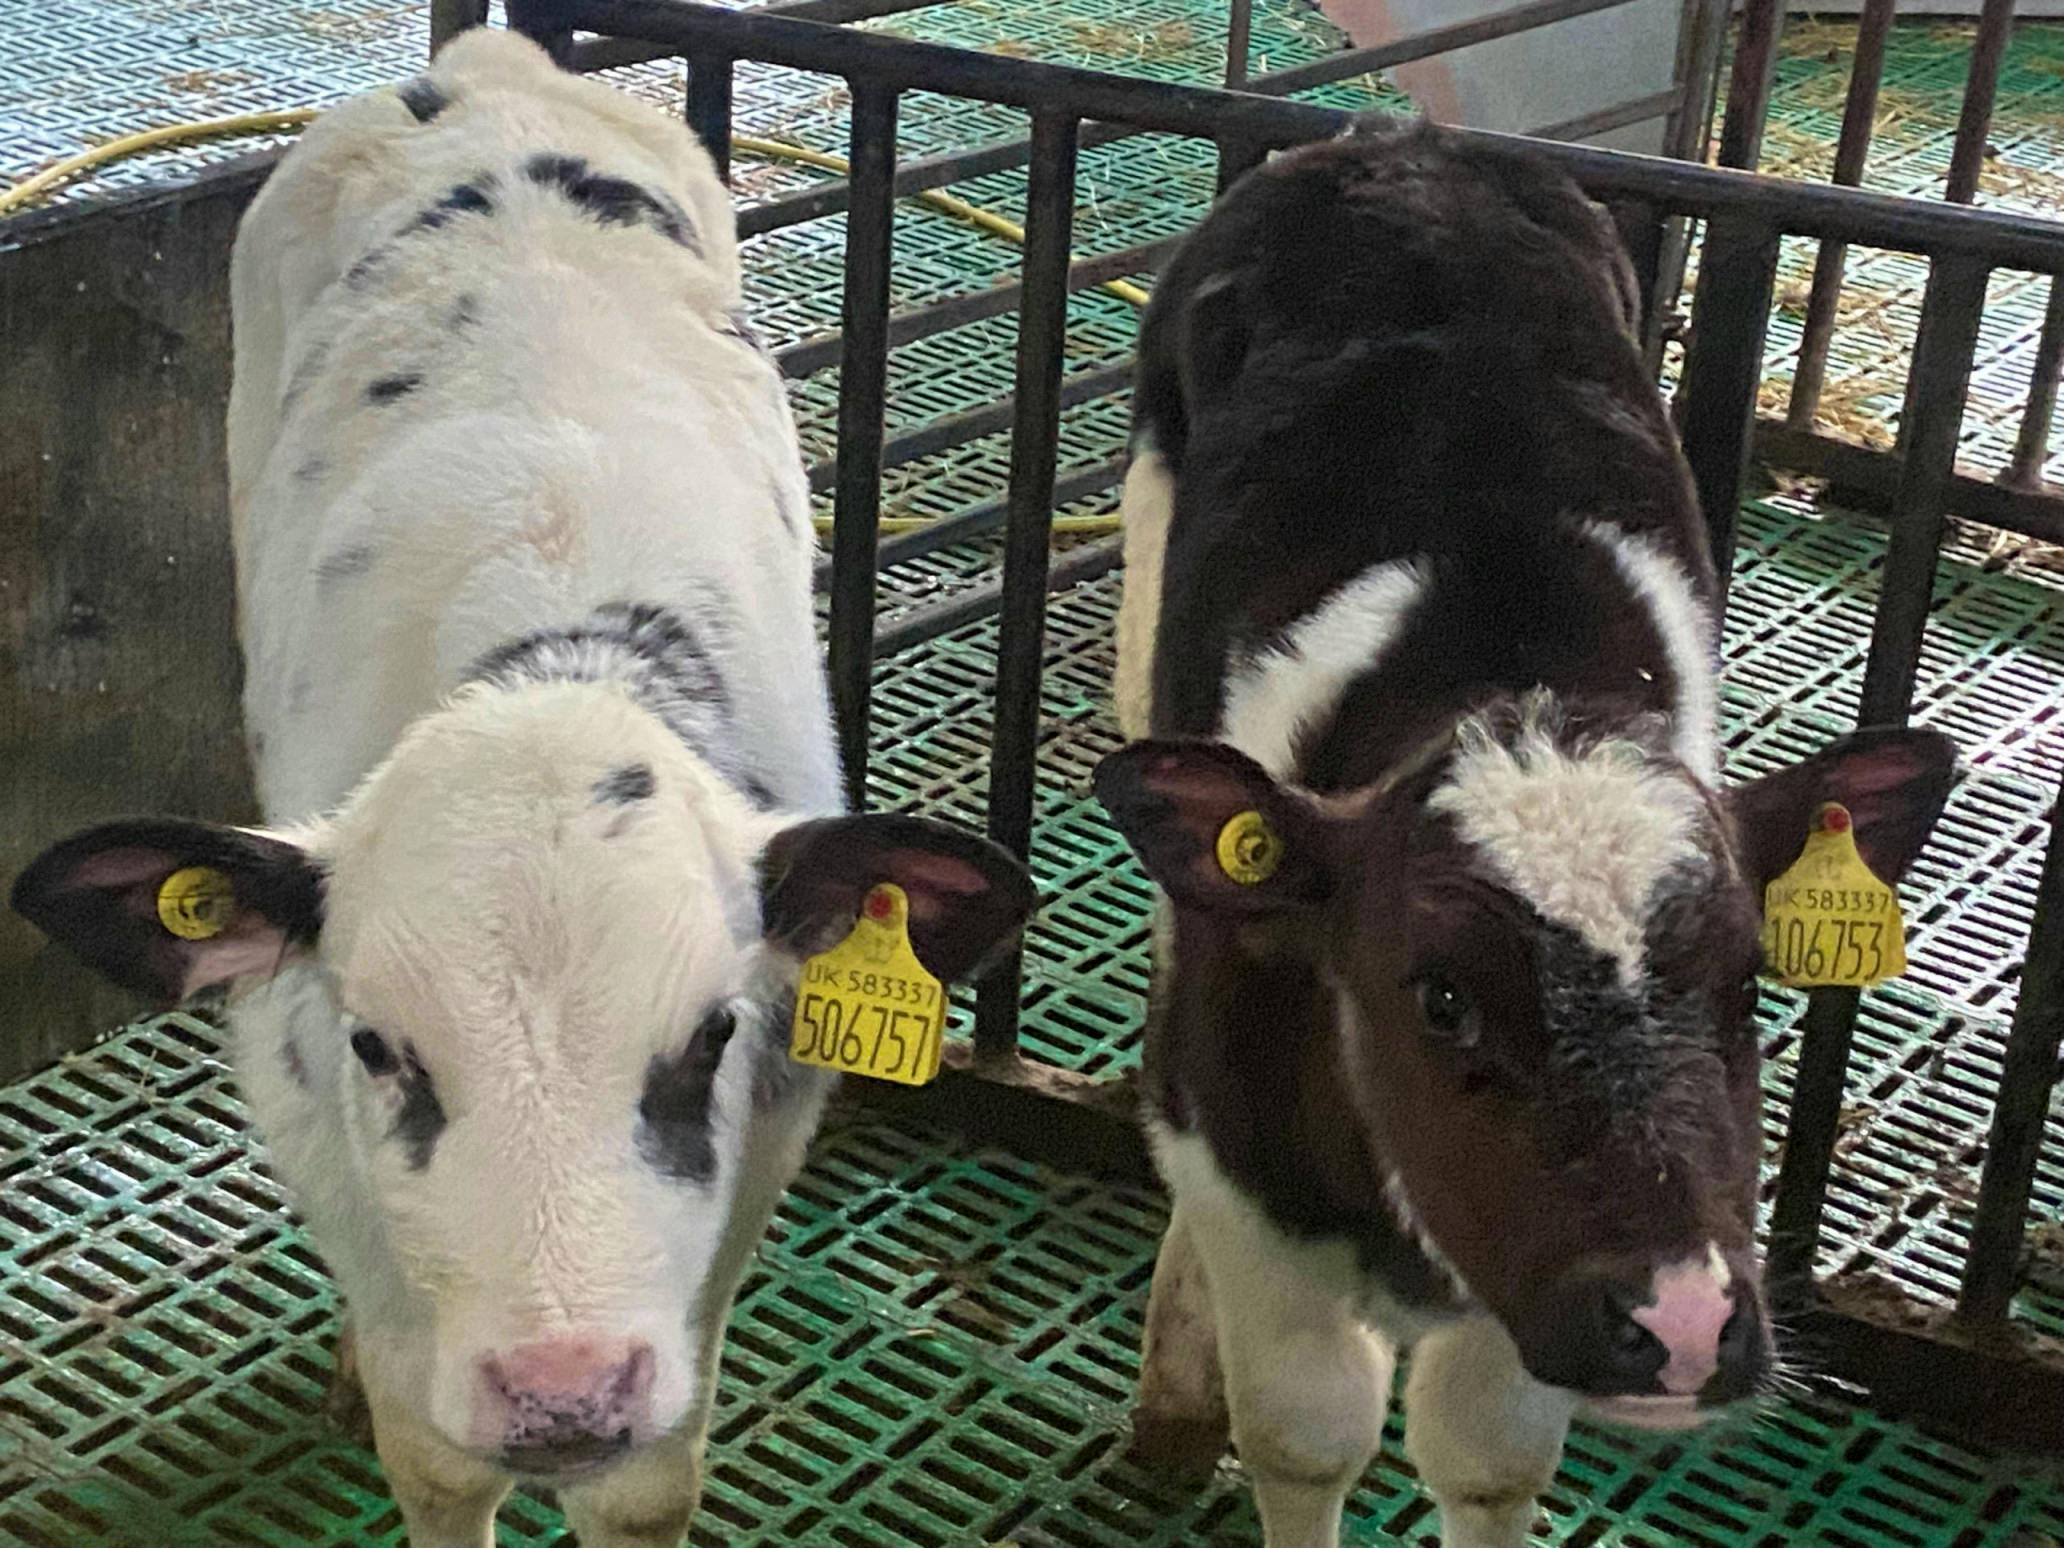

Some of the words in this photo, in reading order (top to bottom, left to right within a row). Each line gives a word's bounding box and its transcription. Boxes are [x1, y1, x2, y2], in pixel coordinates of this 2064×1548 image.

[1806, 888, 1889, 913] 583337
[1771, 917, 1884, 982] 106753
[805, 963, 839, 988] UK
[846, 969, 937, 1008] 583337
[797, 993, 931, 1078] 506757
